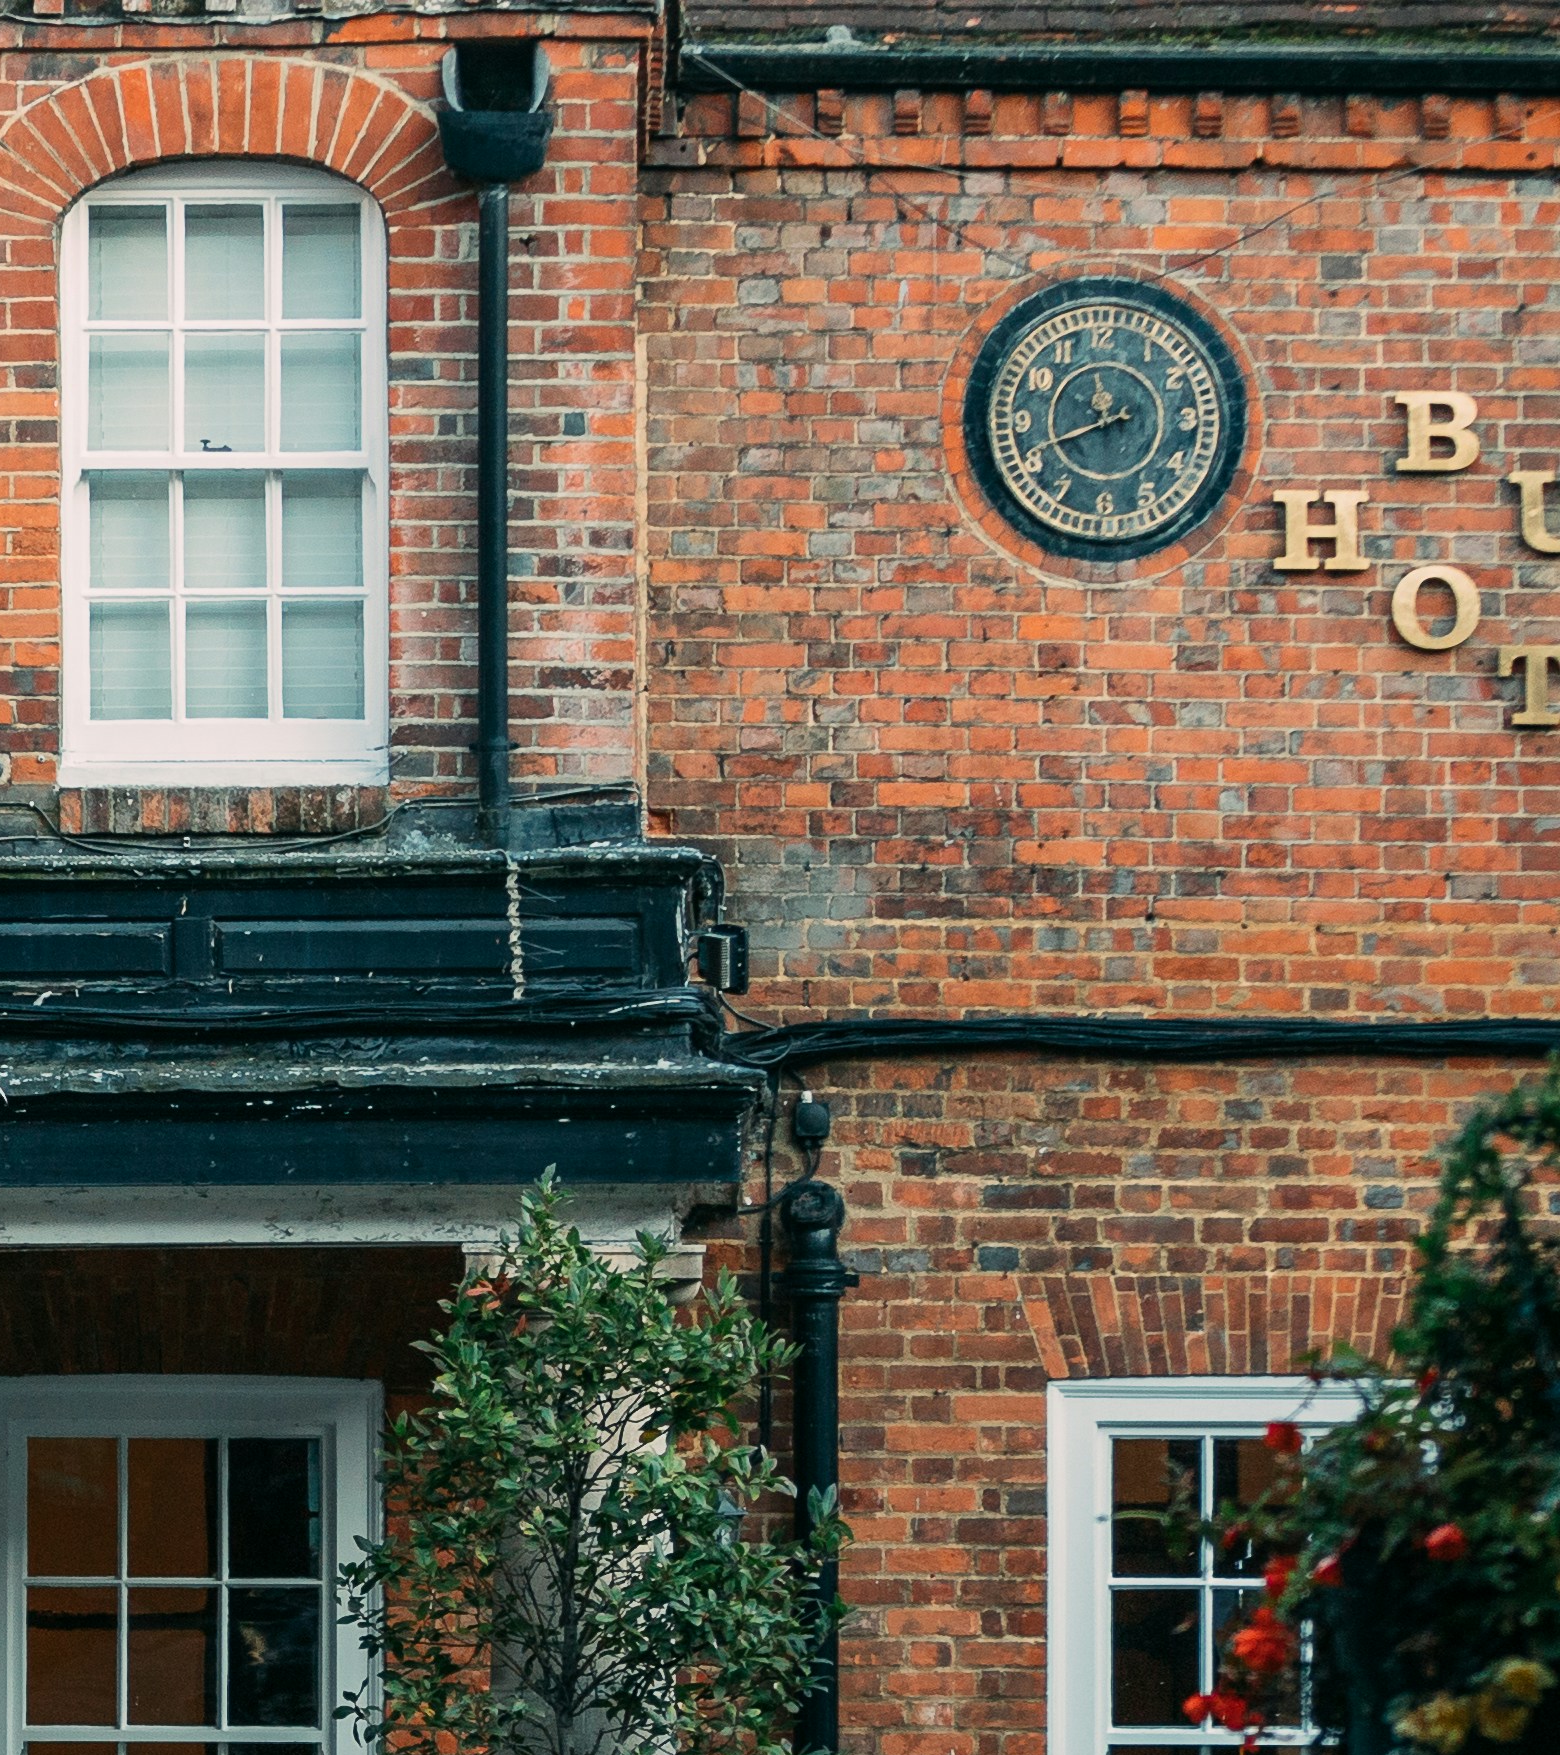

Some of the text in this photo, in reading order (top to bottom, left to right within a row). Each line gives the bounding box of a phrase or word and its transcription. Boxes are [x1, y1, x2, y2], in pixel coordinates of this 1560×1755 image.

[1091, 327, 1115, 350] 12
[1143, 338, 1152, 362] 1
[1054, 340, 1075, 364] 11
[1028, 367, 1054, 392] 10
[1166, 367, 1183, 390] 2
[1014, 409, 1032, 433] 9
[1179, 407, 1198, 431] 3
[1025, 450, 1043, 473] 8
[1167, 451, 1185, 475] 4
[1053, 478, 1072, 501] 7
[1138, 482, 1156, 506] 5
[1095, 492, 1114, 514] 6
